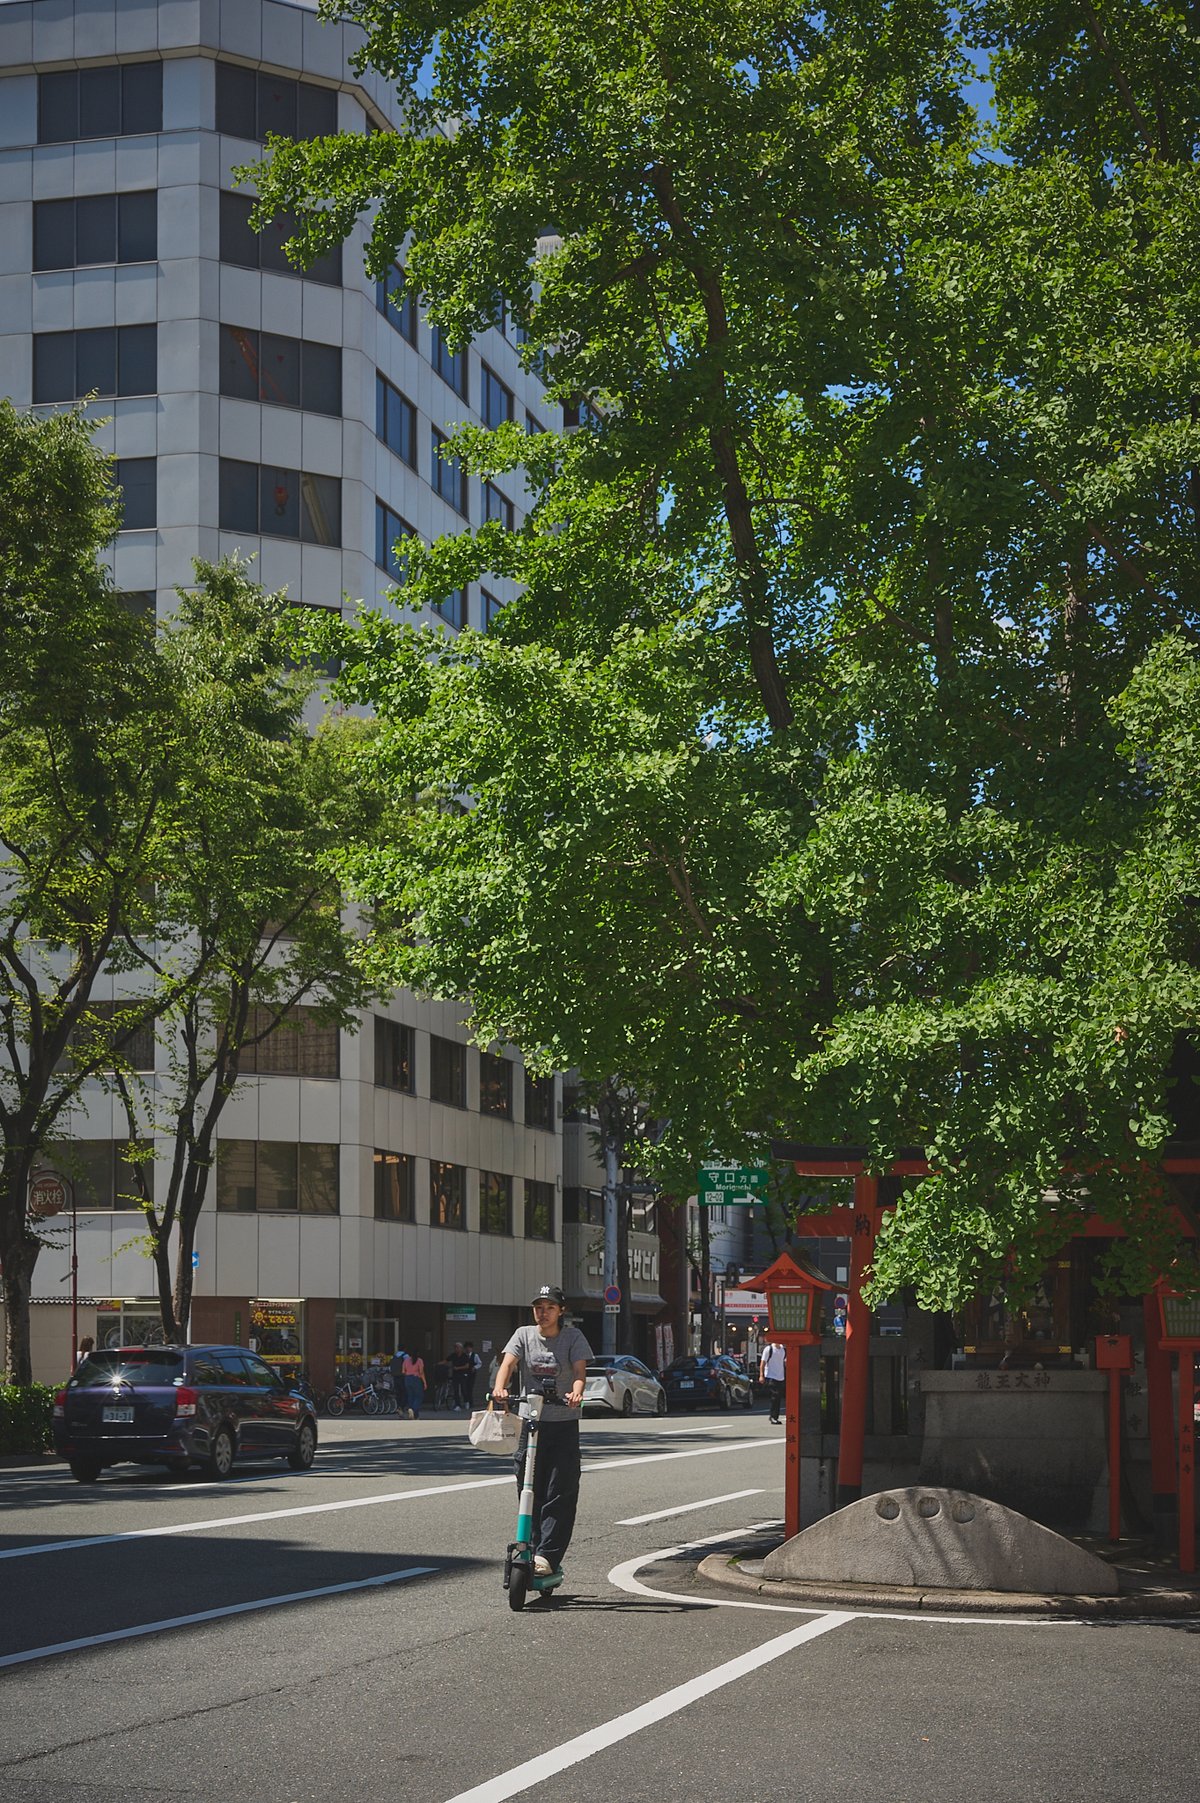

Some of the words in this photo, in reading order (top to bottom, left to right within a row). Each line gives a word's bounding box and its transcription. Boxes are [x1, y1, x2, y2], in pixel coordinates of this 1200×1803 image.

[33, 1189, 63, 1206] 消火栓
[706, 1192, 723, 1202] 12-02
[269, 1315, 296, 1324] てるてる
[976, 1371, 1052, 1389] 龍王大神
